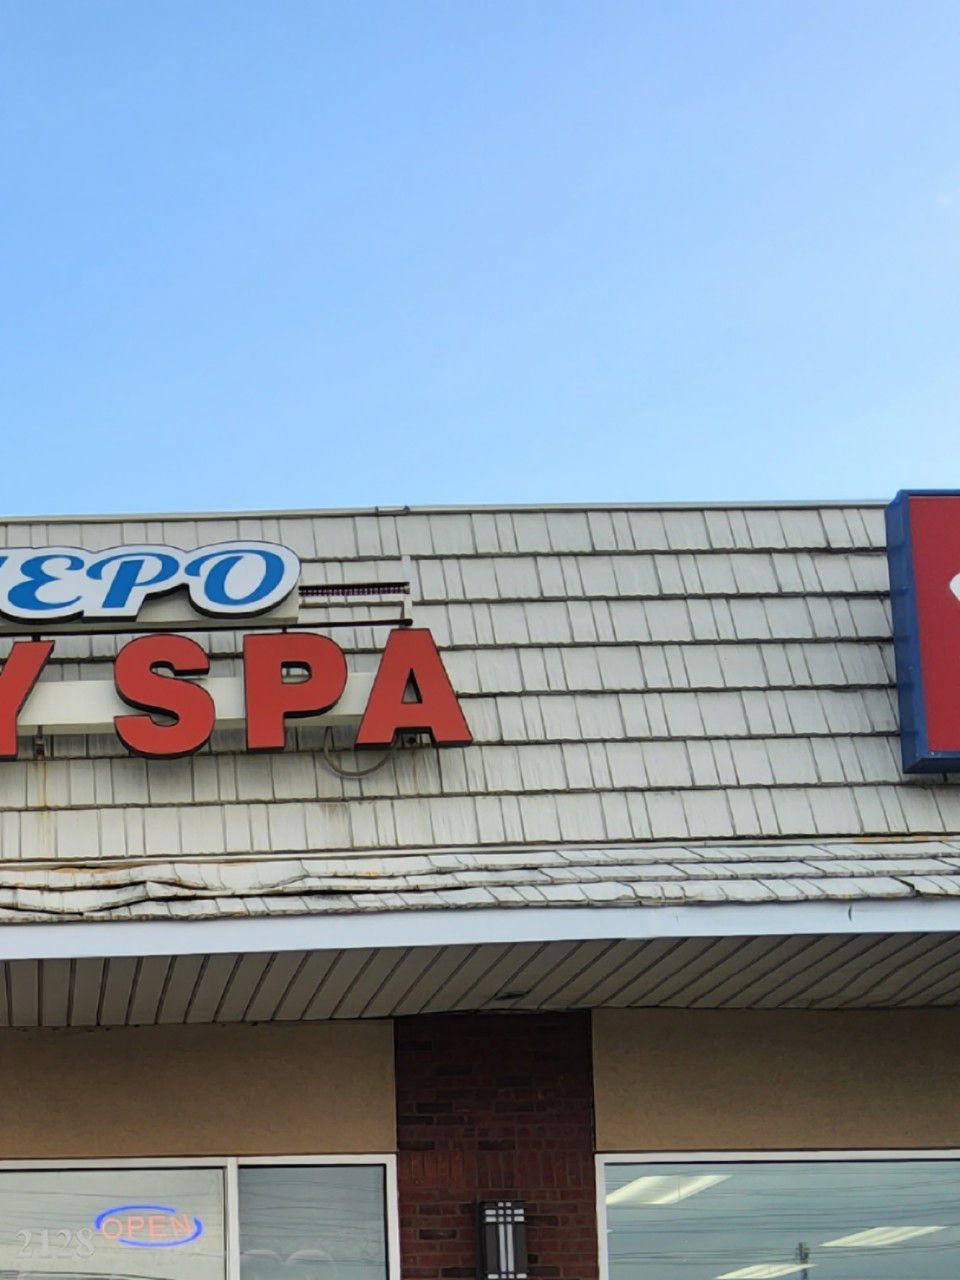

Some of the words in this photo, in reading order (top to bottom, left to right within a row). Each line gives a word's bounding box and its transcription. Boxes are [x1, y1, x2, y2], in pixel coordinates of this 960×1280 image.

[113, 628, 474, 758] SPA
[101, 1213, 194, 1240] OPEN
[15, 1228, 96, 1259] 2128
